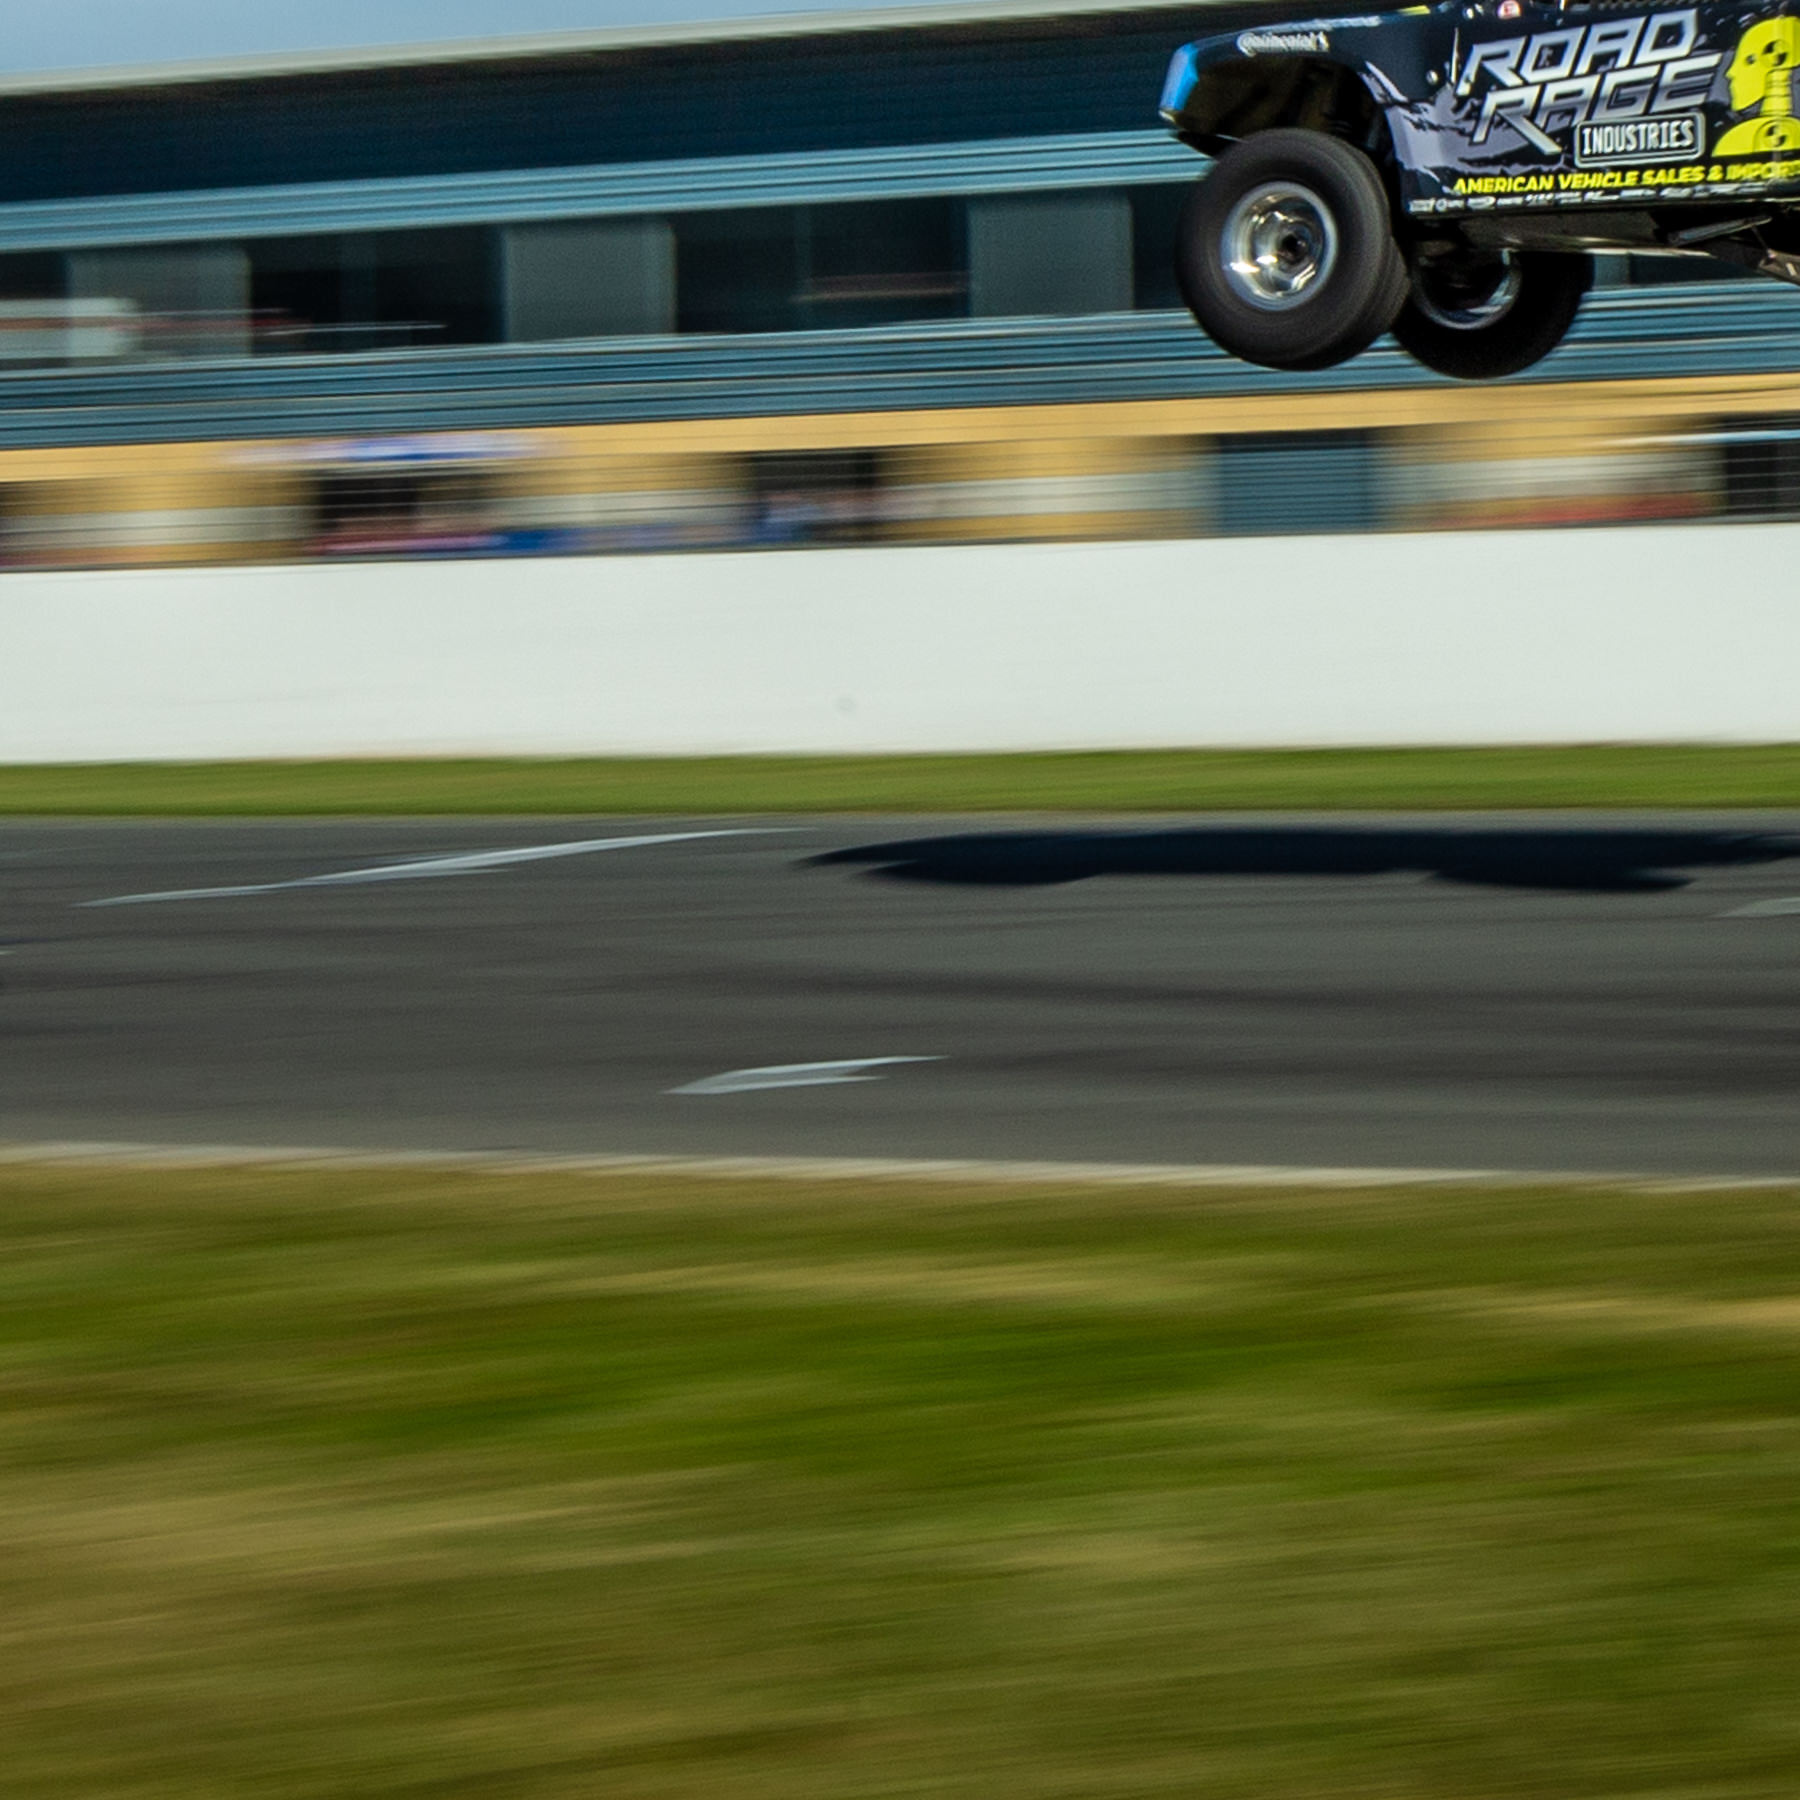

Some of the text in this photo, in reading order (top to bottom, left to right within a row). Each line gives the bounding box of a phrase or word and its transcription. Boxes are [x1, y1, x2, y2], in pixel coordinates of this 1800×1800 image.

[1455, 8, 1699, 97] ROAD
[1470, 53, 1722, 155] RAGE
[1581, 121, 1694, 155] INDUSTRIES
[1453, 174, 1555, 194] AMERICAN
[1558, 168, 1639, 188] VEHICLE
[1641, 163, 1706, 185] SALES
[1707, 162, 1723, 181] &
